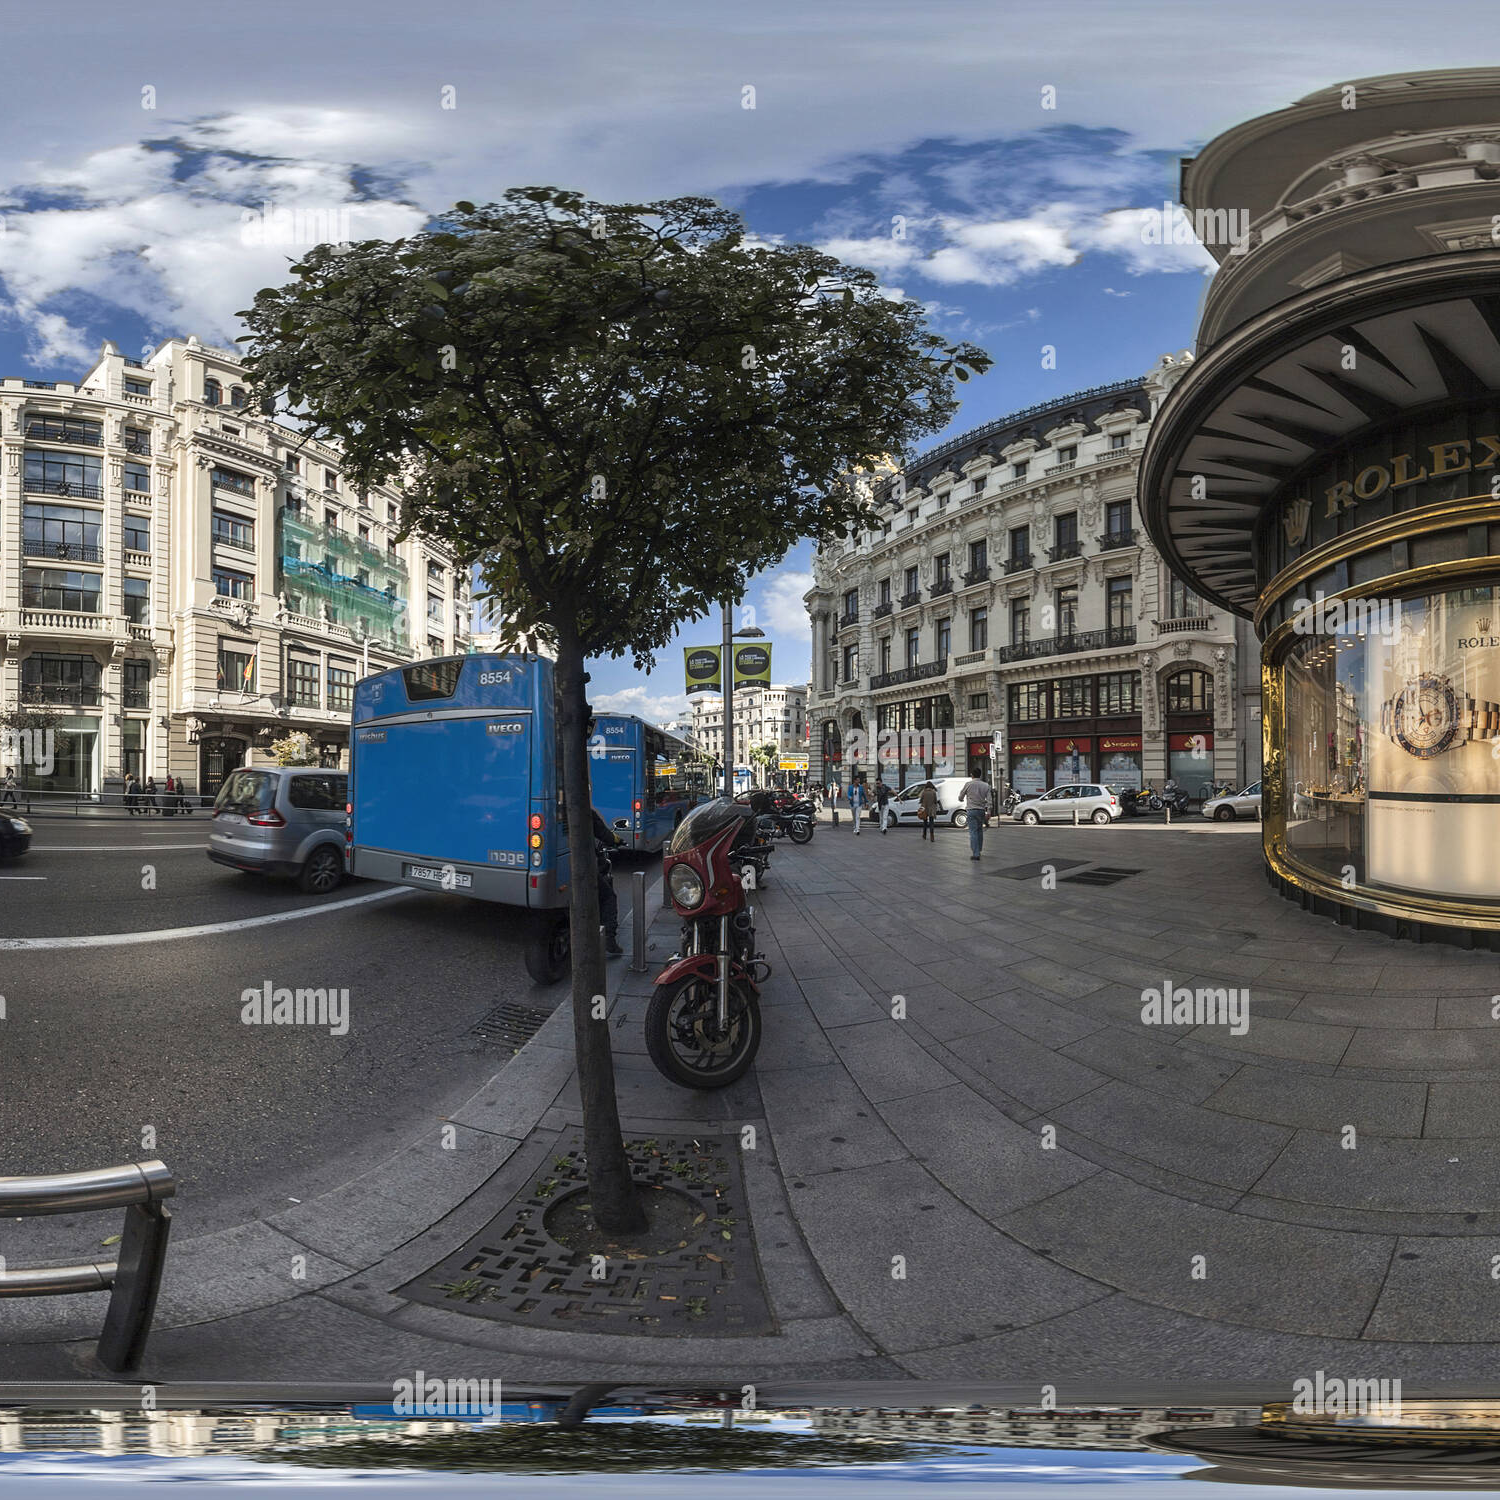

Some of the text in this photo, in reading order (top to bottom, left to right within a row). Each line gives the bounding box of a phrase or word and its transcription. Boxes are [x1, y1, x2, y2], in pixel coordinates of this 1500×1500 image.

[480, 671, 511, 685] 8554
[488, 724, 522, 733] IVECO
[605, 726, 624, 735] 8554
[413, 866, 432, 878] 7857
[455, 874, 469, 885] SP
